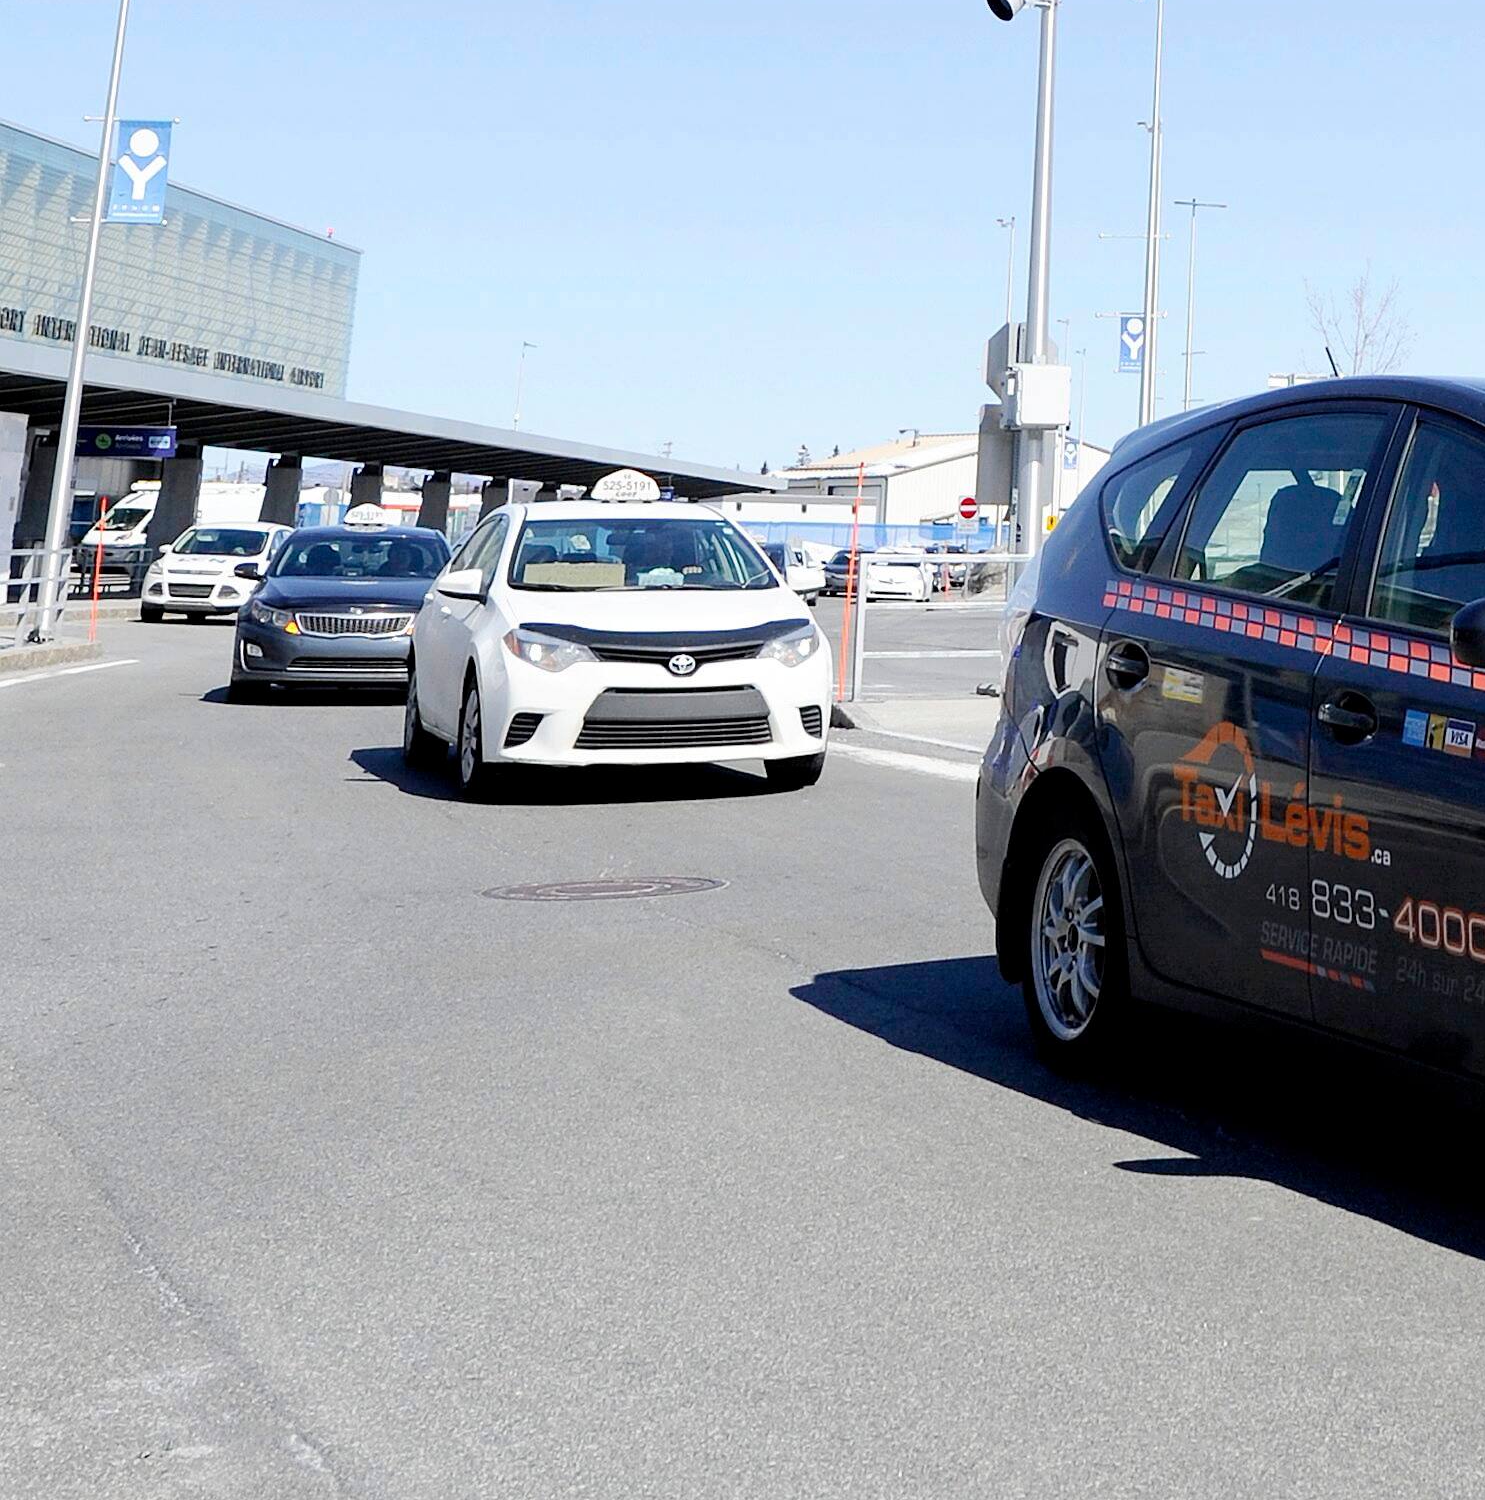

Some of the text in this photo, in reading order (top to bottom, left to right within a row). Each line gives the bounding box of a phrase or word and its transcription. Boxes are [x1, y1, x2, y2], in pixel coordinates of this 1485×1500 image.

[603, 480, 651, 491] 525-5191
[1451, 729, 1469, 746] VISA
[1173, 764, 1245, 833] Taxi
[1265, 883, 1300, 911] 418
[1260, 920, 1377, 974] SERVICE RAPIDE
[1395, 957, 1426, 989] 24h
[1432, 972, 1458, 996] sur
